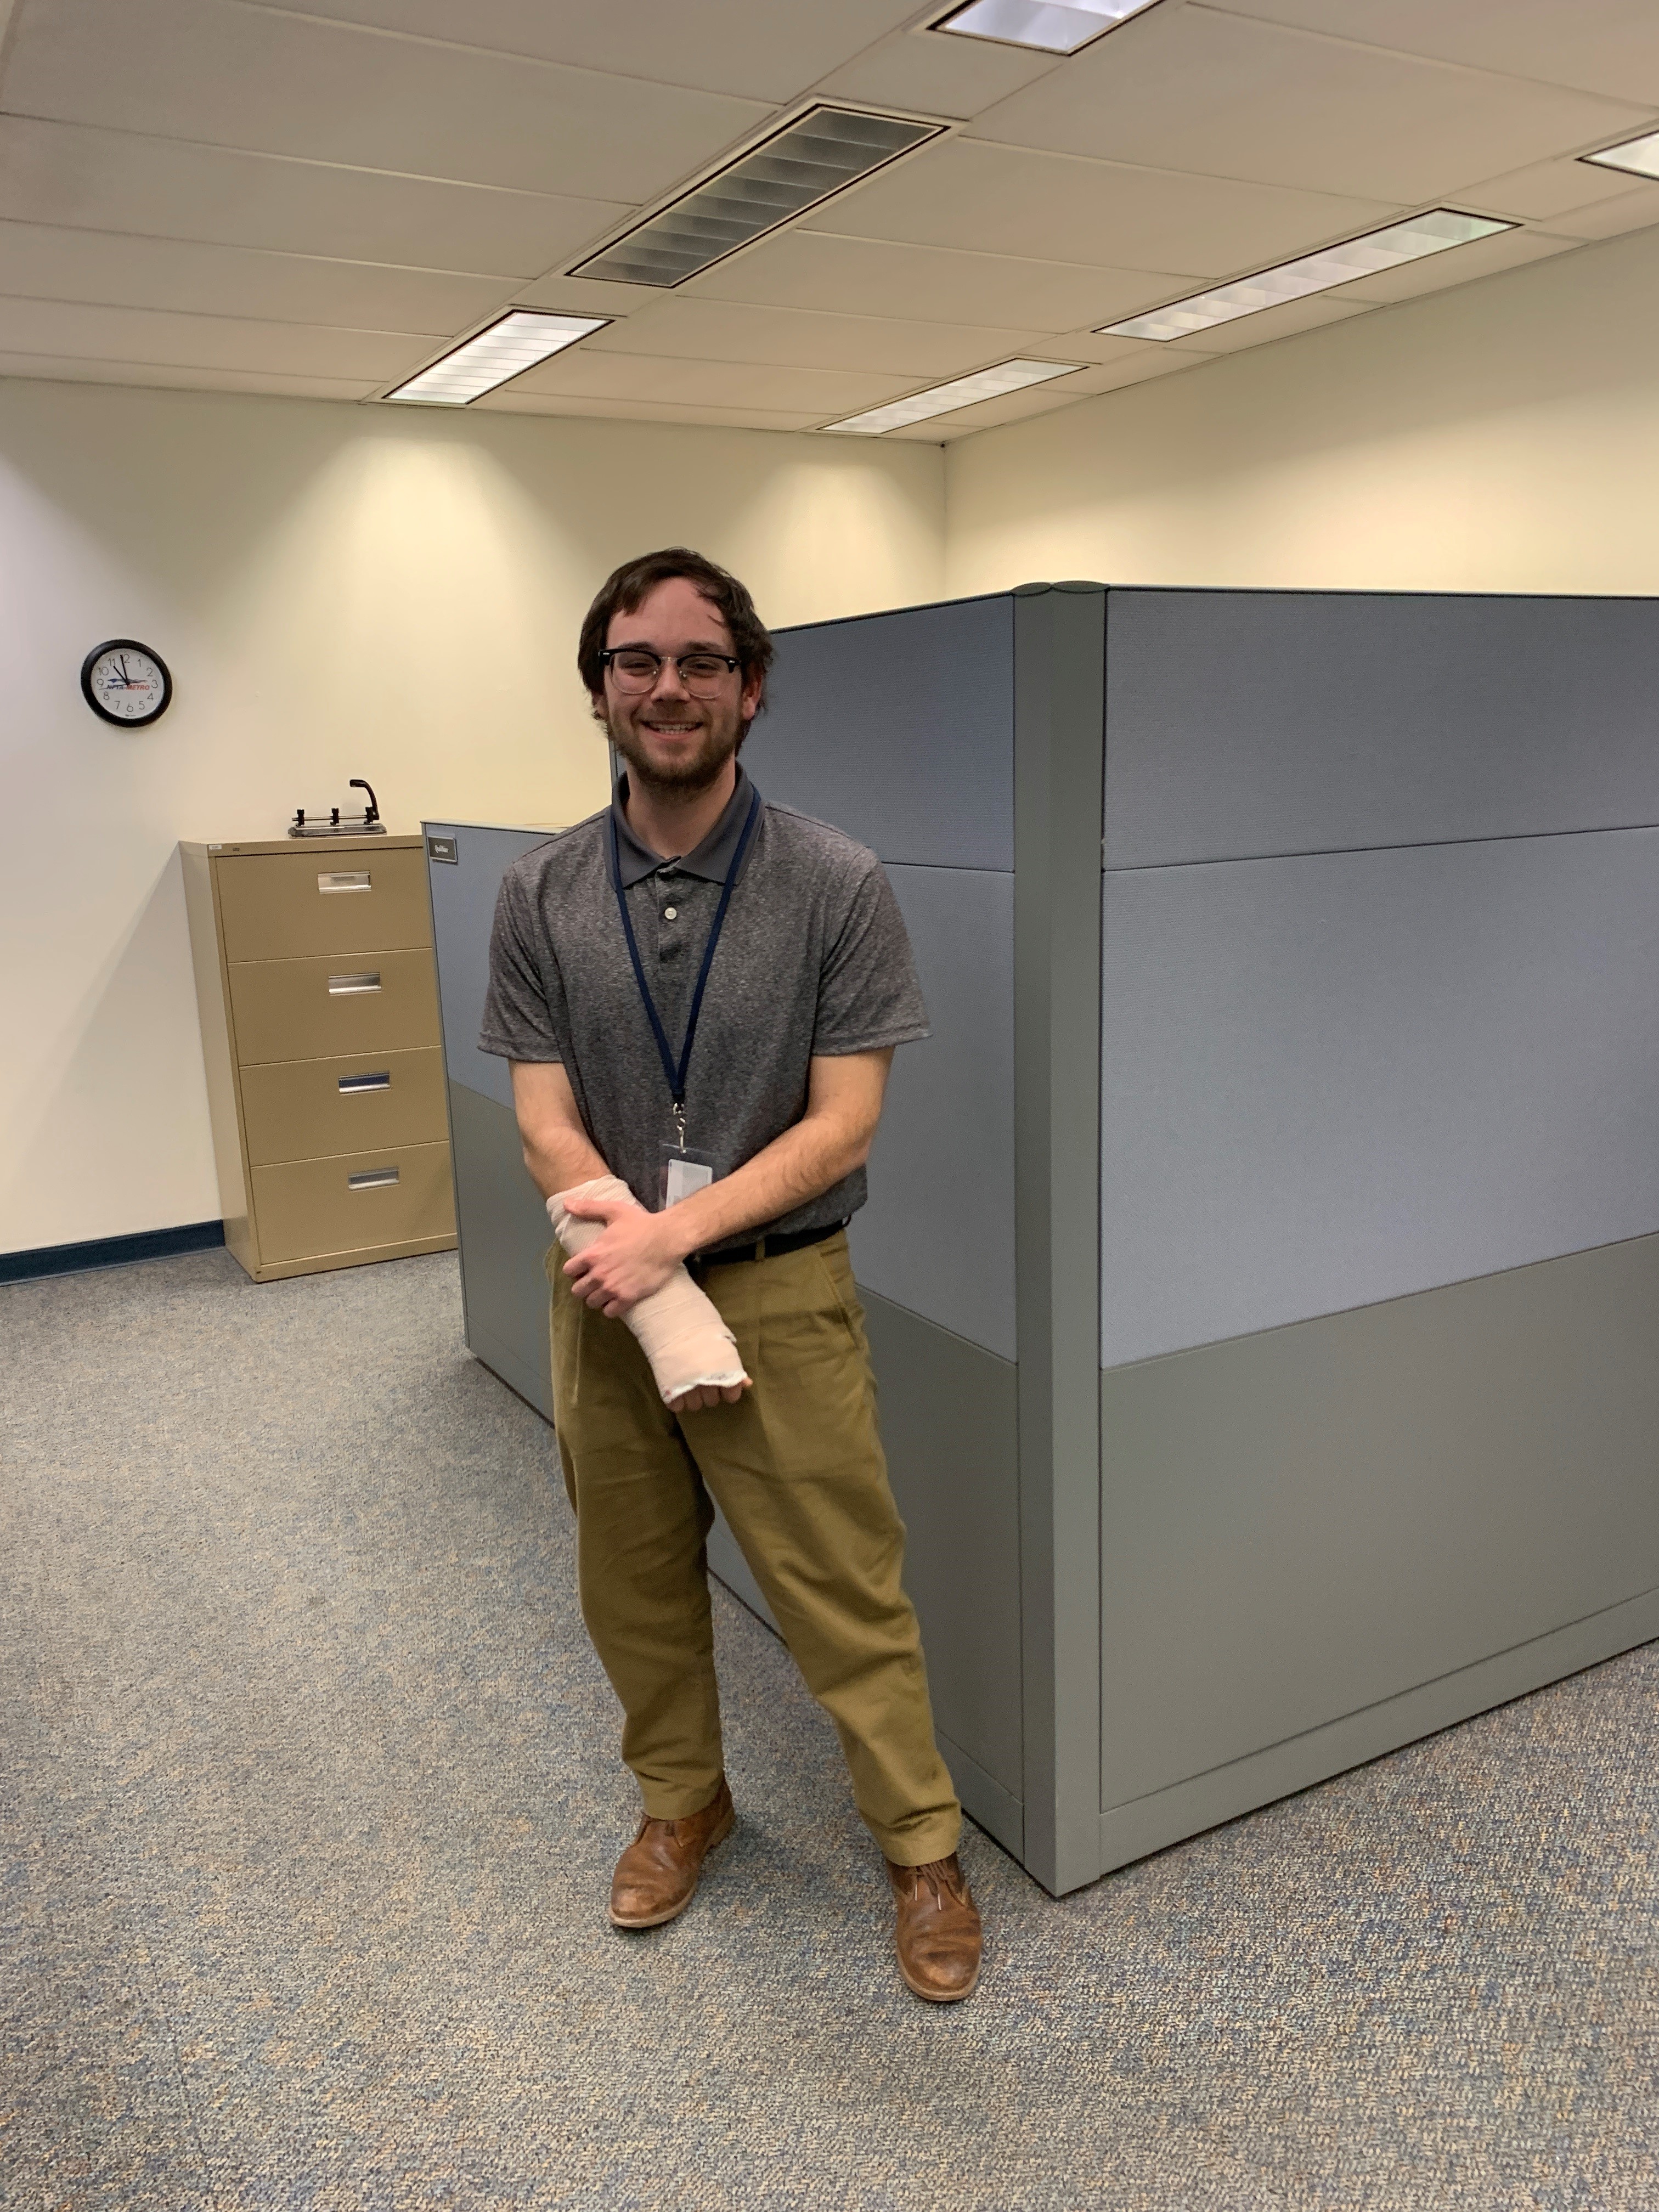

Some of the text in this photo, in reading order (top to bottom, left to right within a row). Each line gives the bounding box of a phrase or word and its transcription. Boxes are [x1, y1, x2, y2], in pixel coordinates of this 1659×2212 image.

[137, 659, 142, 667] 1
[98, 666, 109, 676] 10
[146, 667, 153, 676] 2
[97, 679, 104, 687] 9
[151, 679, 159, 689] 3
[103, 691, 110, 701] 8
[146, 692, 154, 701] 4
[114, 701, 120, 709] 7
[126, 703, 133, 712] 6
[138, 701, 145, 710] 5
